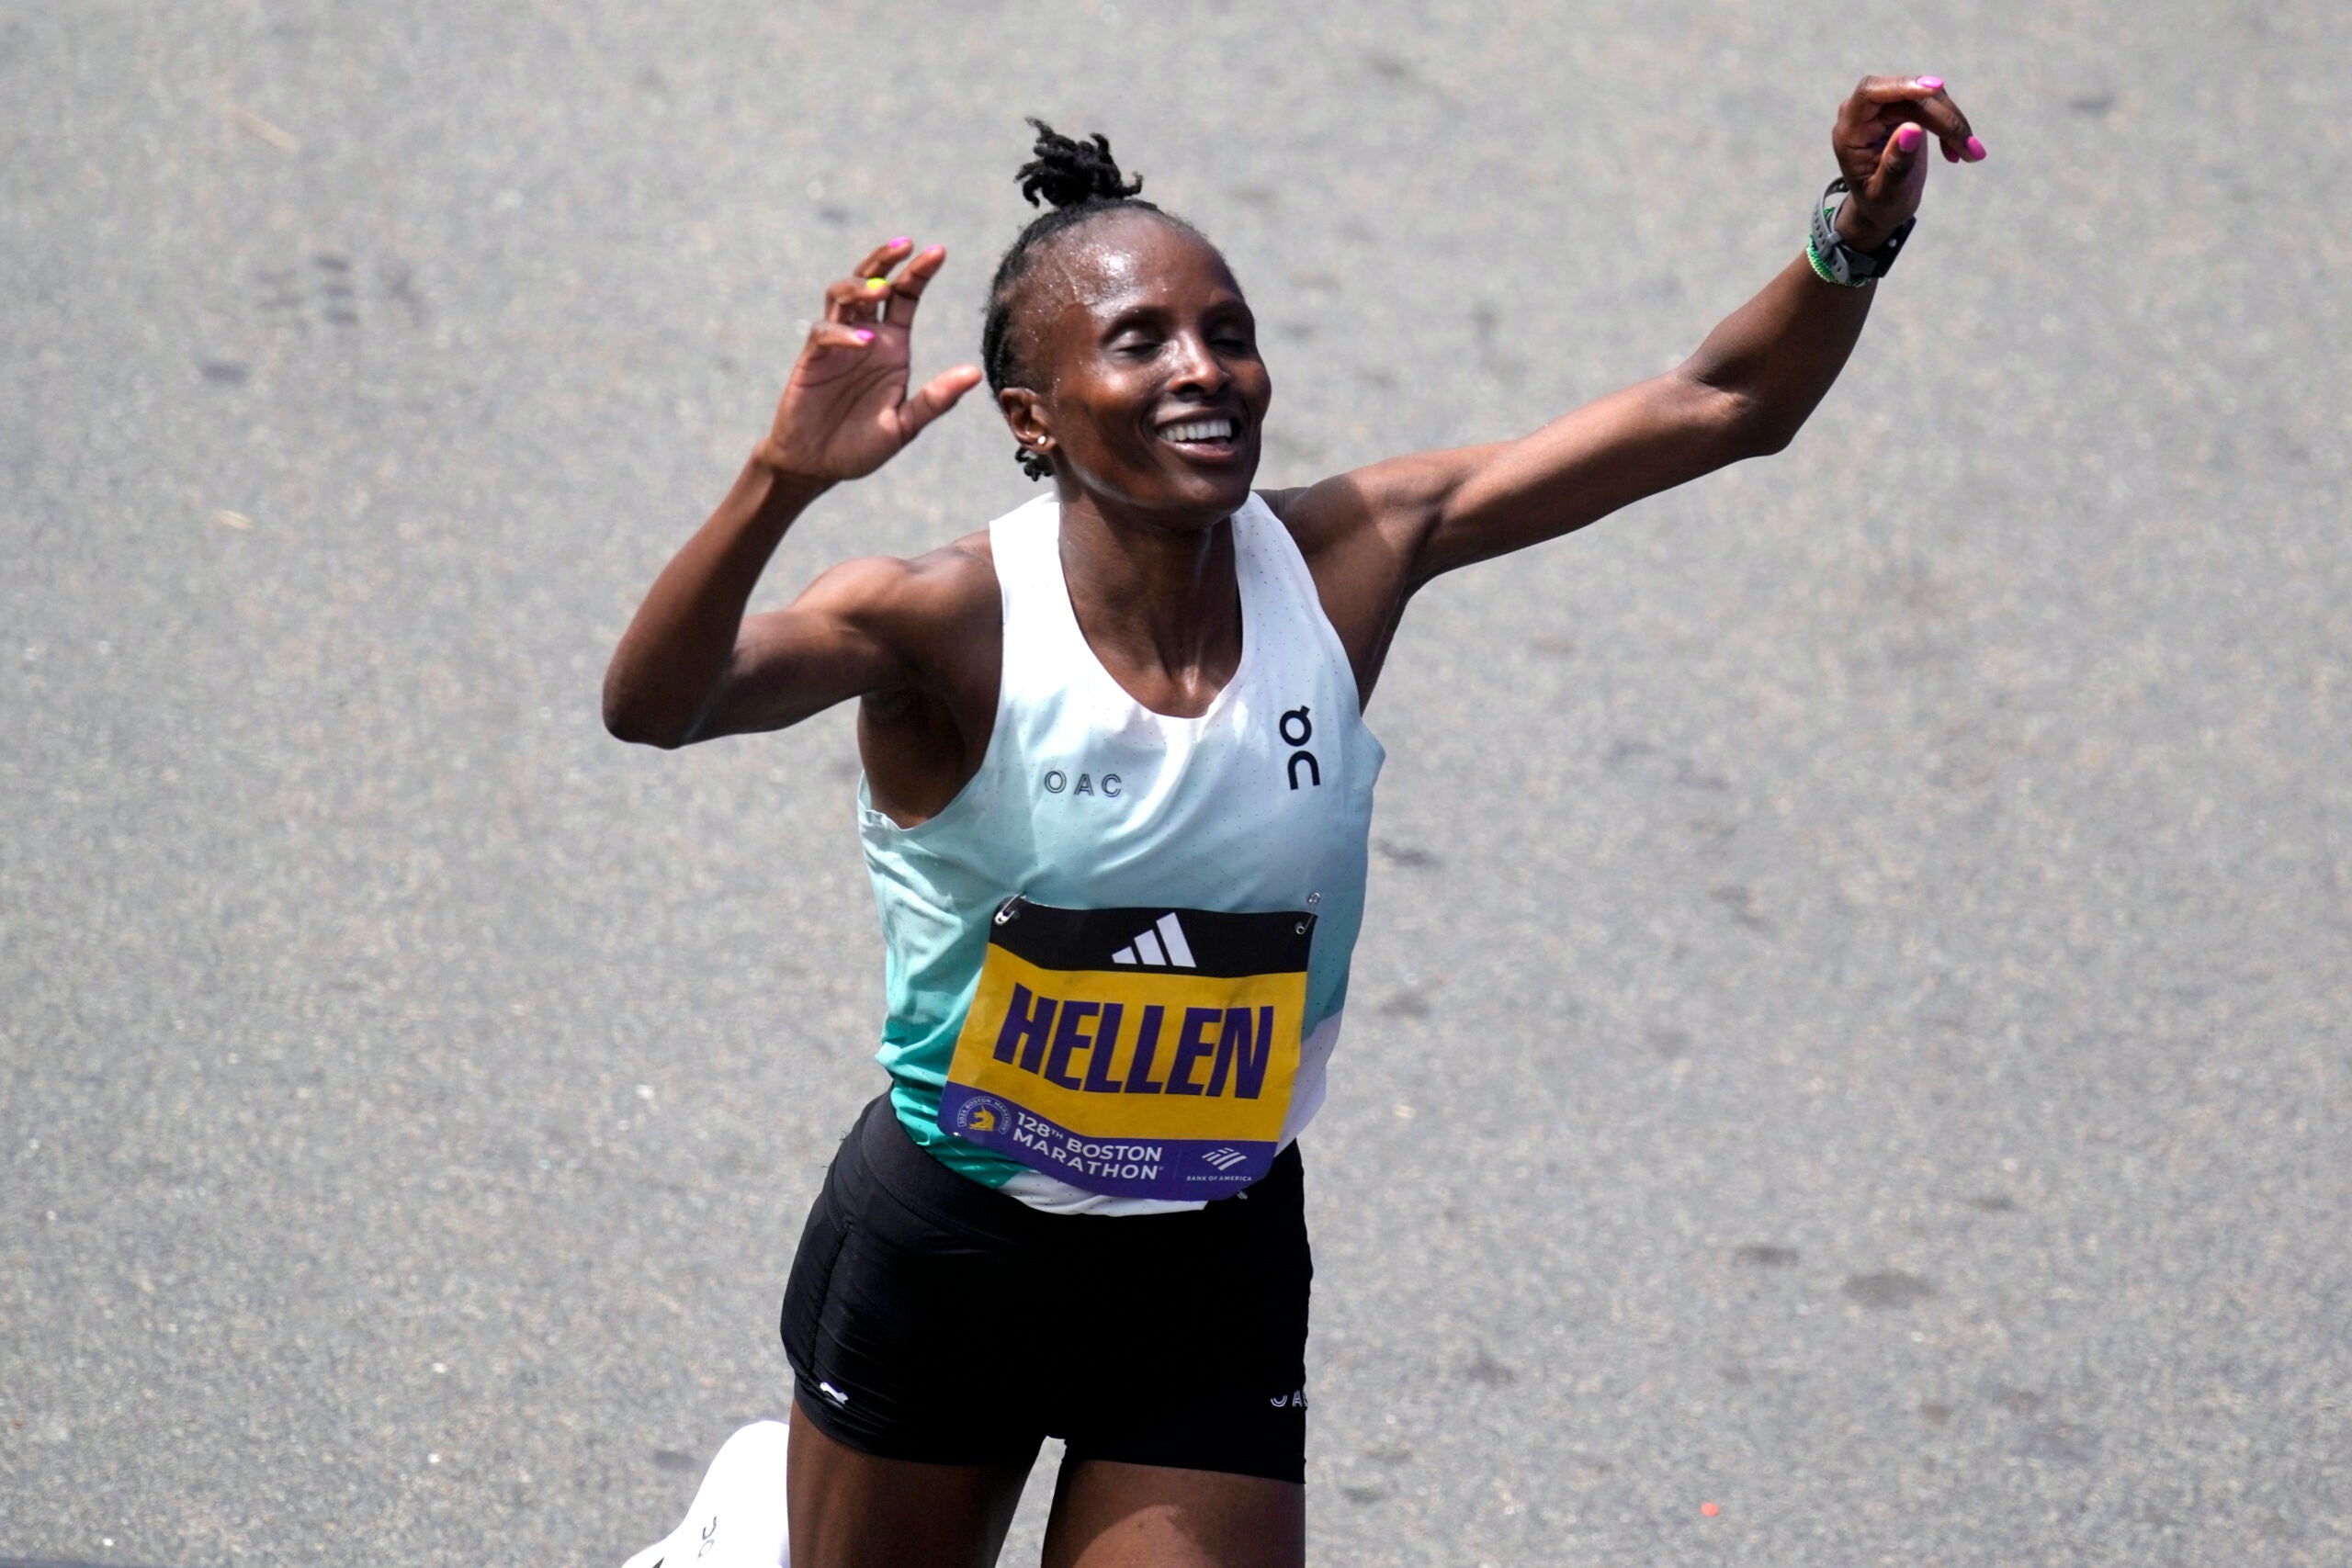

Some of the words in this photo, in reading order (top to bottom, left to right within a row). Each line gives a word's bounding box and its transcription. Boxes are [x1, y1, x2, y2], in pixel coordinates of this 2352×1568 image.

[1044, 770, 1123, 799] OAC
[992, 982, 1274, 1100] HELLEN
[1066, 1137, 1162, 1163] BOSTON
